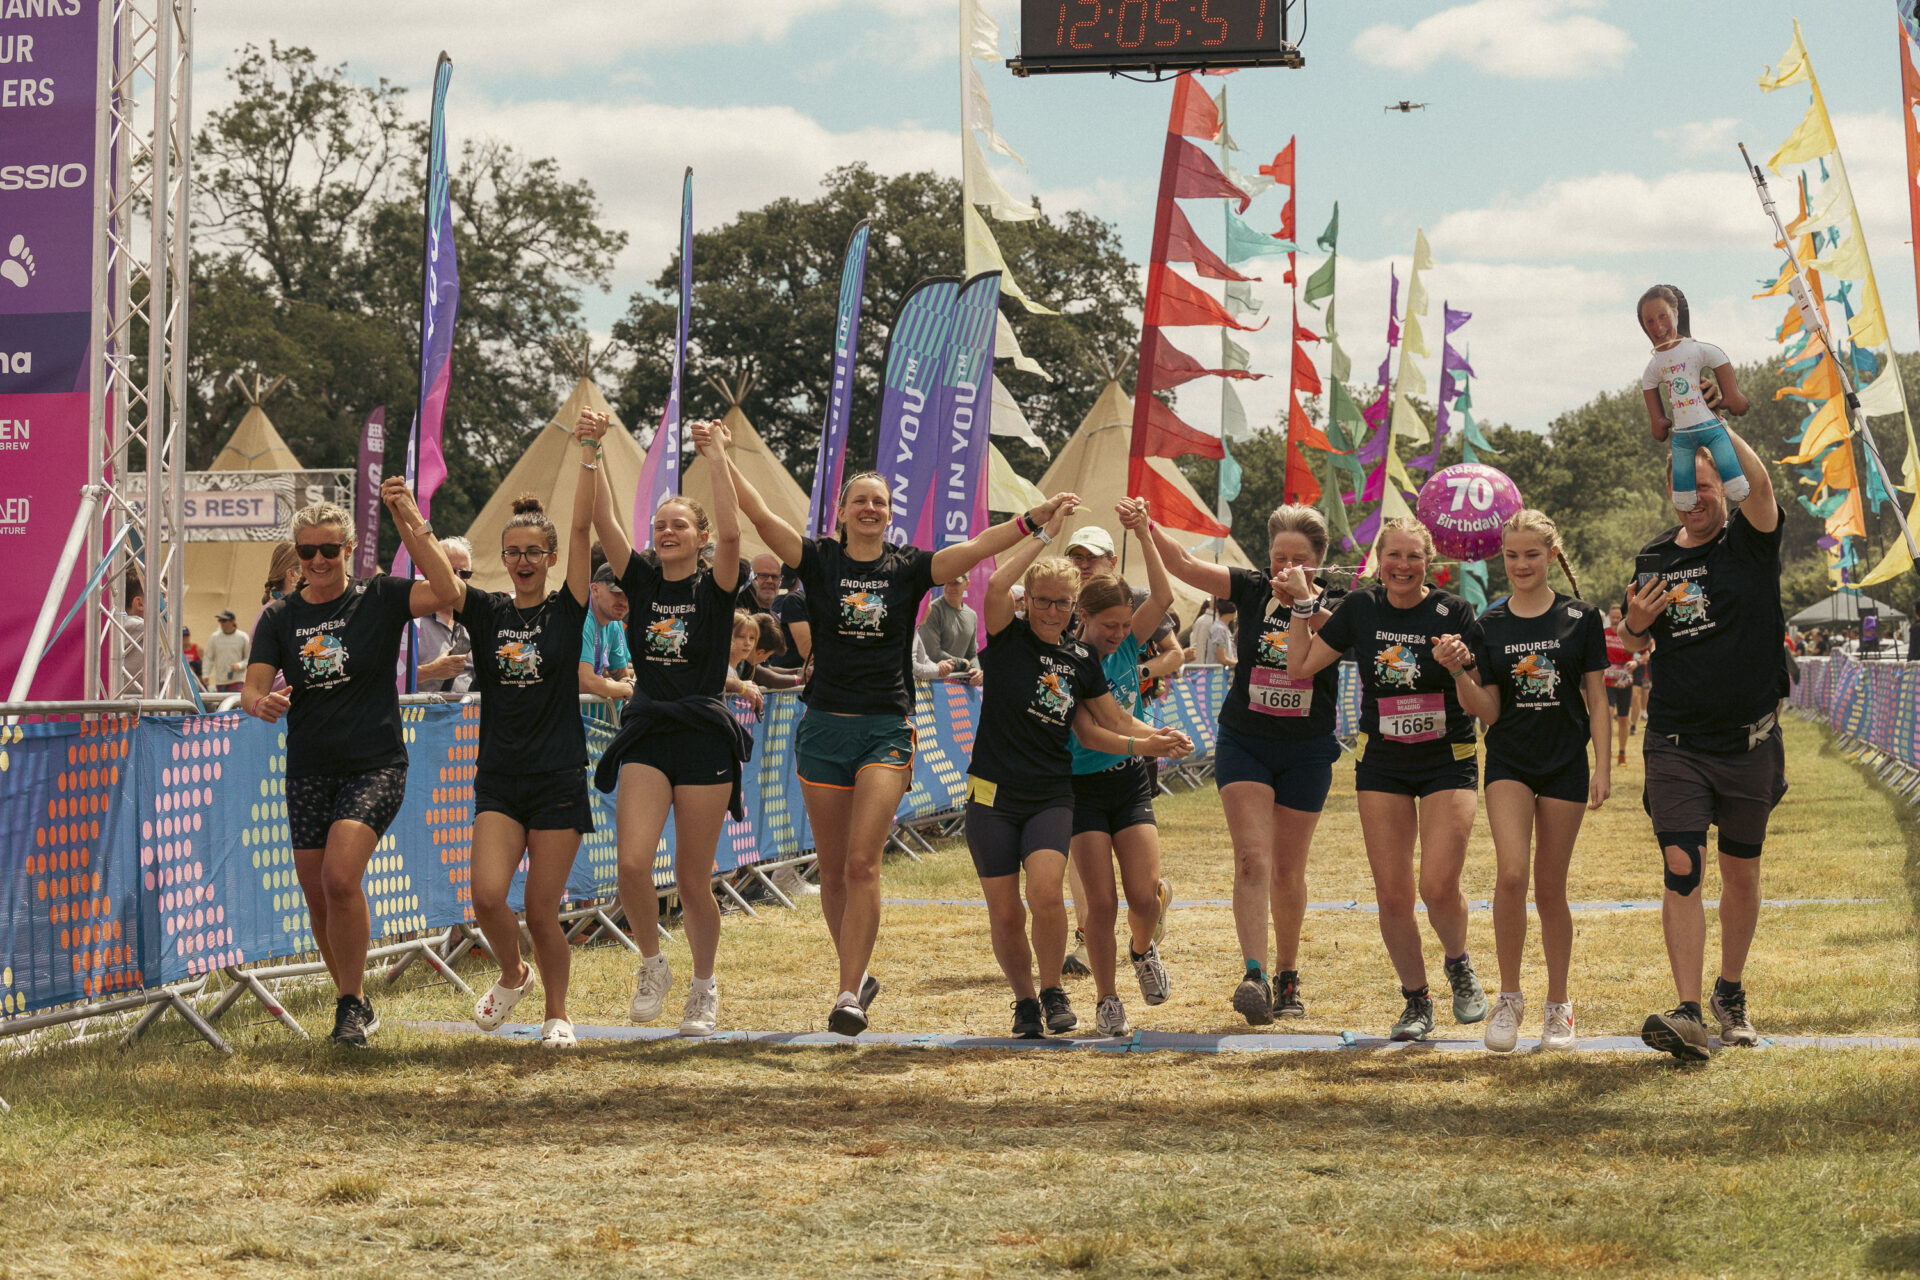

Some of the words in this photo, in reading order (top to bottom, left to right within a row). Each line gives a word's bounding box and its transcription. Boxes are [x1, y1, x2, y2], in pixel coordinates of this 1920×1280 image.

[0, 0, 81, 19] ANKS
[2, 77, 55, 107] ERS
[947, 463, 966, 500] IN
[1446, 477, 1495, 512] 70
[205, 498, 263, 517] REST
[945, 510, 968, 543] IS
[1436, 511, 1503, 532] Birthday!
[1260, 690, 1302, 708] 1668
[1391, 716, 1434, 735] 1665
